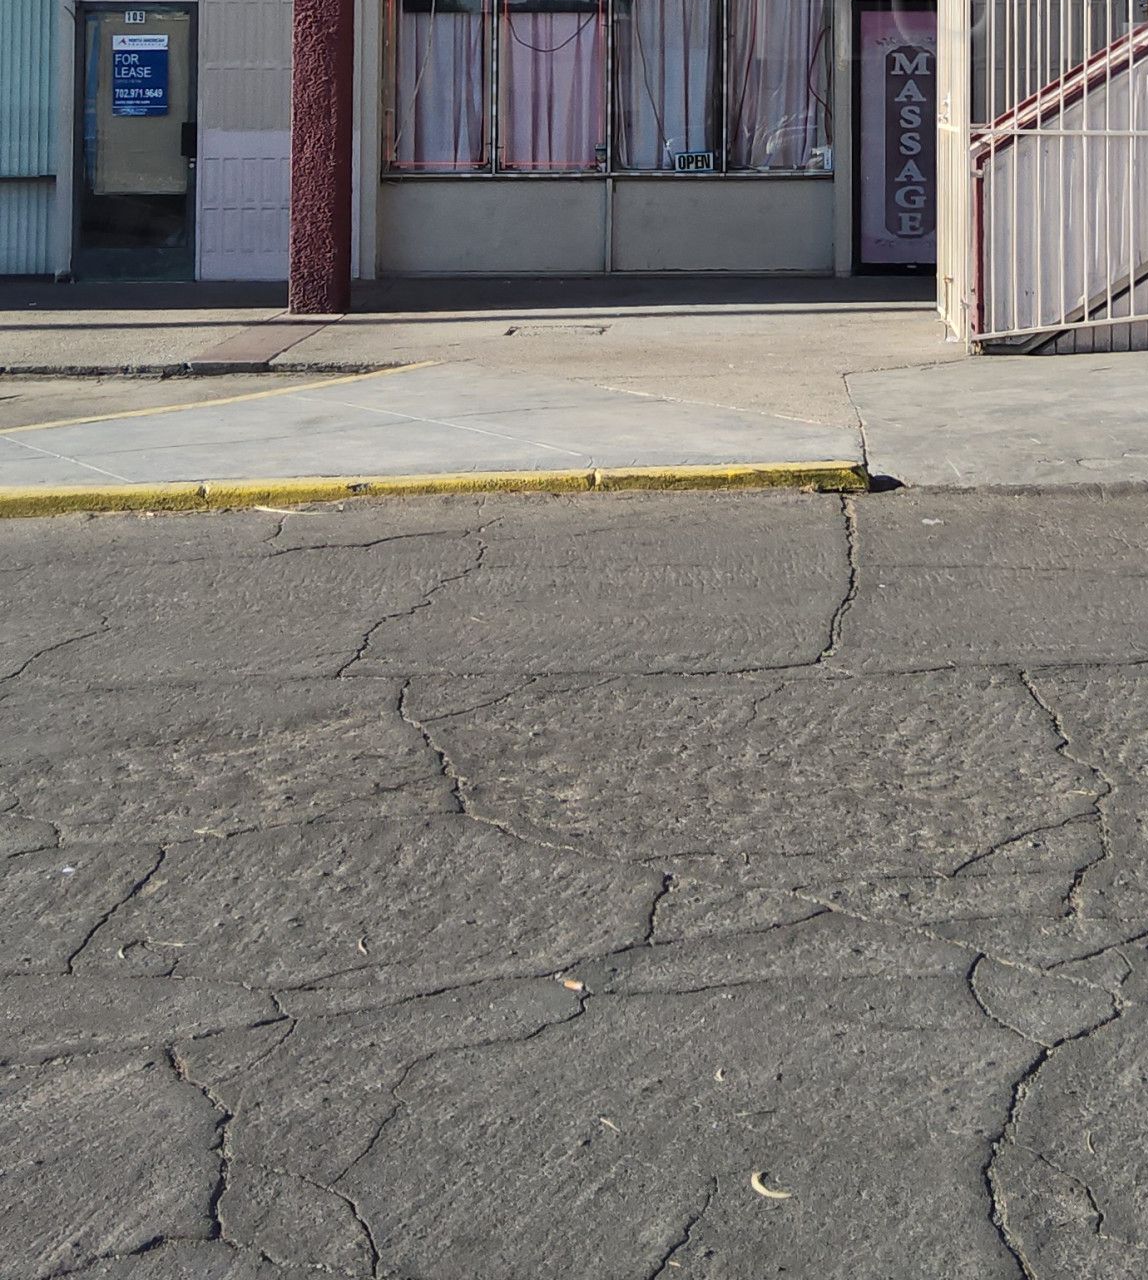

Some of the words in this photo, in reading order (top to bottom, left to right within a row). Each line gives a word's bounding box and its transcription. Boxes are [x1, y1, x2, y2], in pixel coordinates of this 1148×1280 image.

[127, 12, 144, 22] 109
[115, 54, 140, 65] FOR
[115, 67, 152, 78] LEASE
[891, 53, 930, 235] MASSAGE
[678, 154, 711, 170] OPEN
